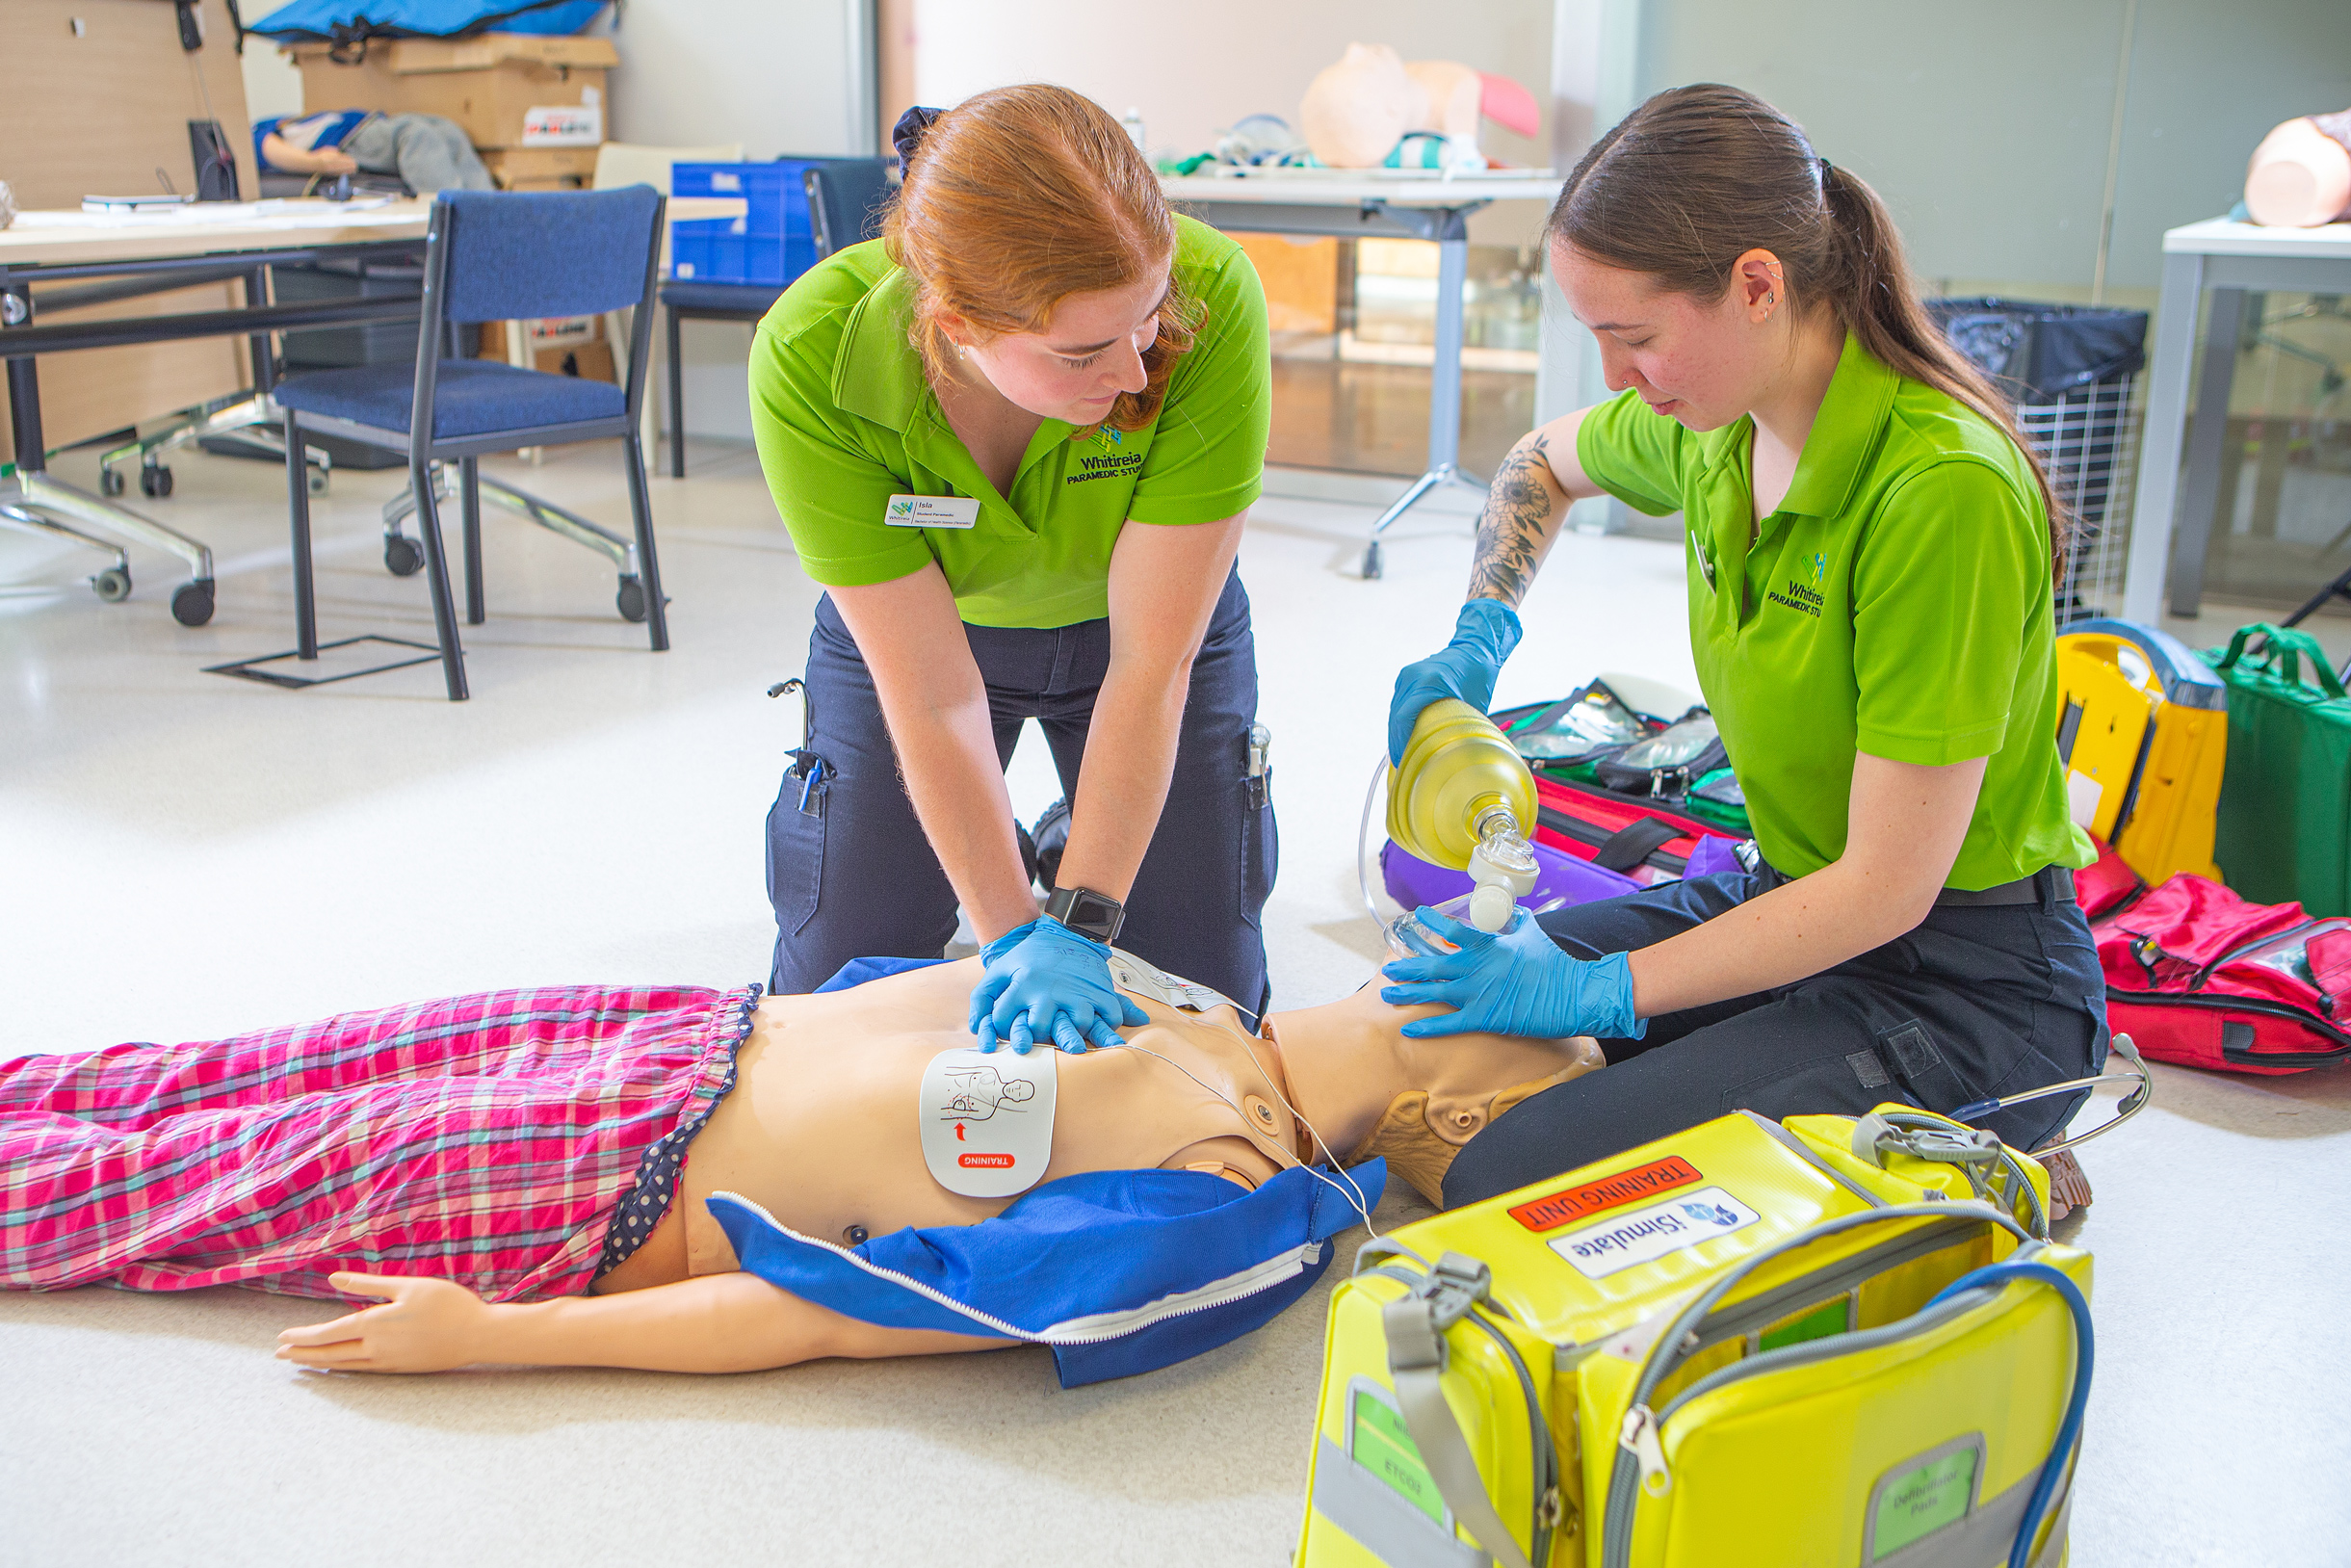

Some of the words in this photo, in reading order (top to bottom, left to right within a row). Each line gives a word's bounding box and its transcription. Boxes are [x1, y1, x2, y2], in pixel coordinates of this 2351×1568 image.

[1067, 470, 1118, 484] PARAMEDIC
[1121, 462, 1144, 477] STU
[1081, 452, 1141, 470] Whitireia
[1768, 591, 1810, 613] PARAMEDIC
[1582, 1164, 1690, 1205] TRAINING
[1527, 1198, 1581, 1224] UNIT
[1571, 1213, 1689, 1258] iSimulate
[1894, 1471, 1957, 1508] Defibrillator
